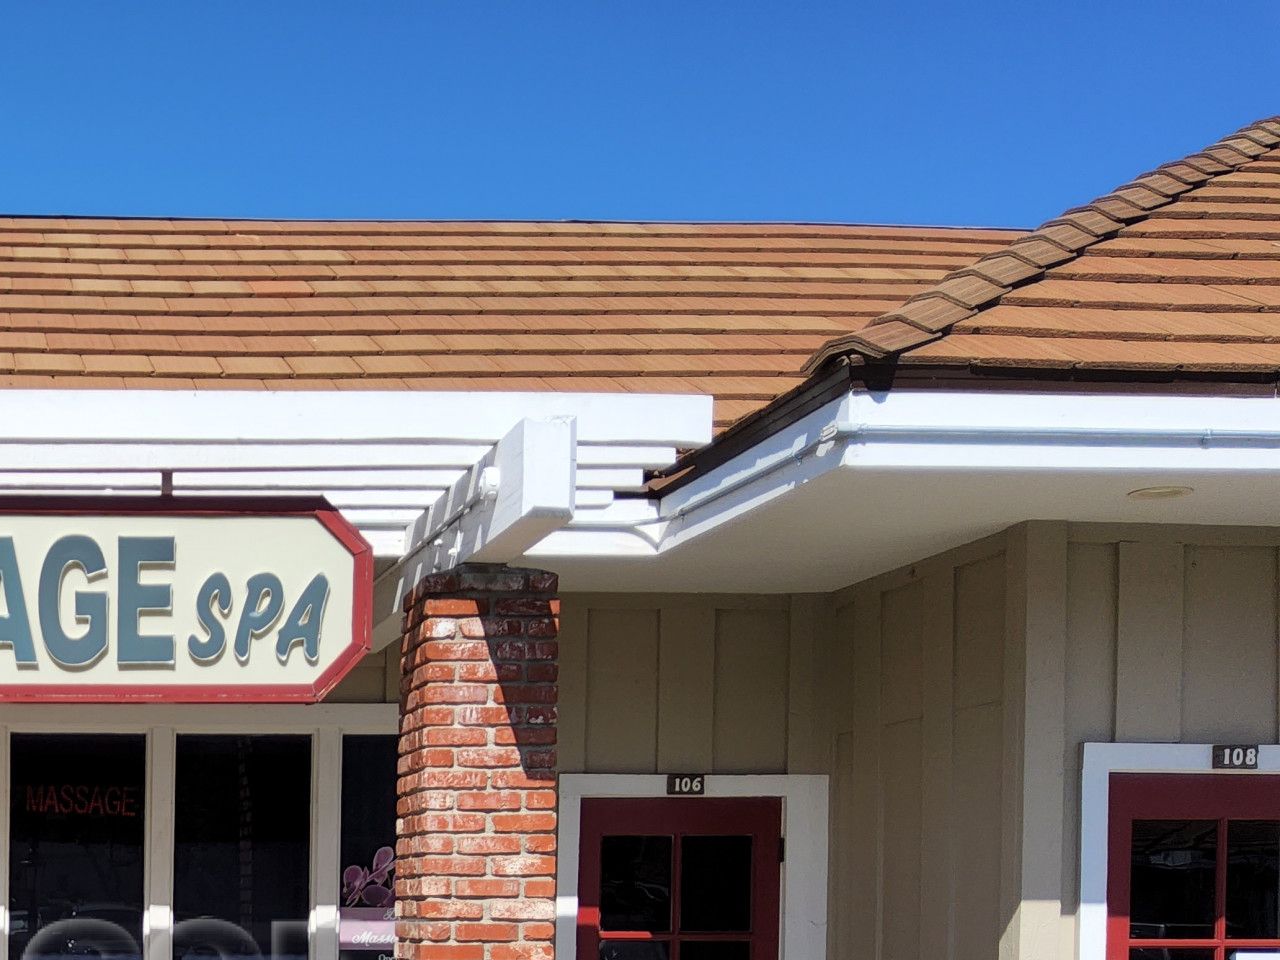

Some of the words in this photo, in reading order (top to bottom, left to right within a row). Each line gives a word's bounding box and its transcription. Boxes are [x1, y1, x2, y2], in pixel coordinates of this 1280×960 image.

[187, 571, 331, 667] SPA
[1223, 748, 1257, 766] 108
[674, 777, 702, 792] 106
[25, 783, 137, 817] MASSAGE
